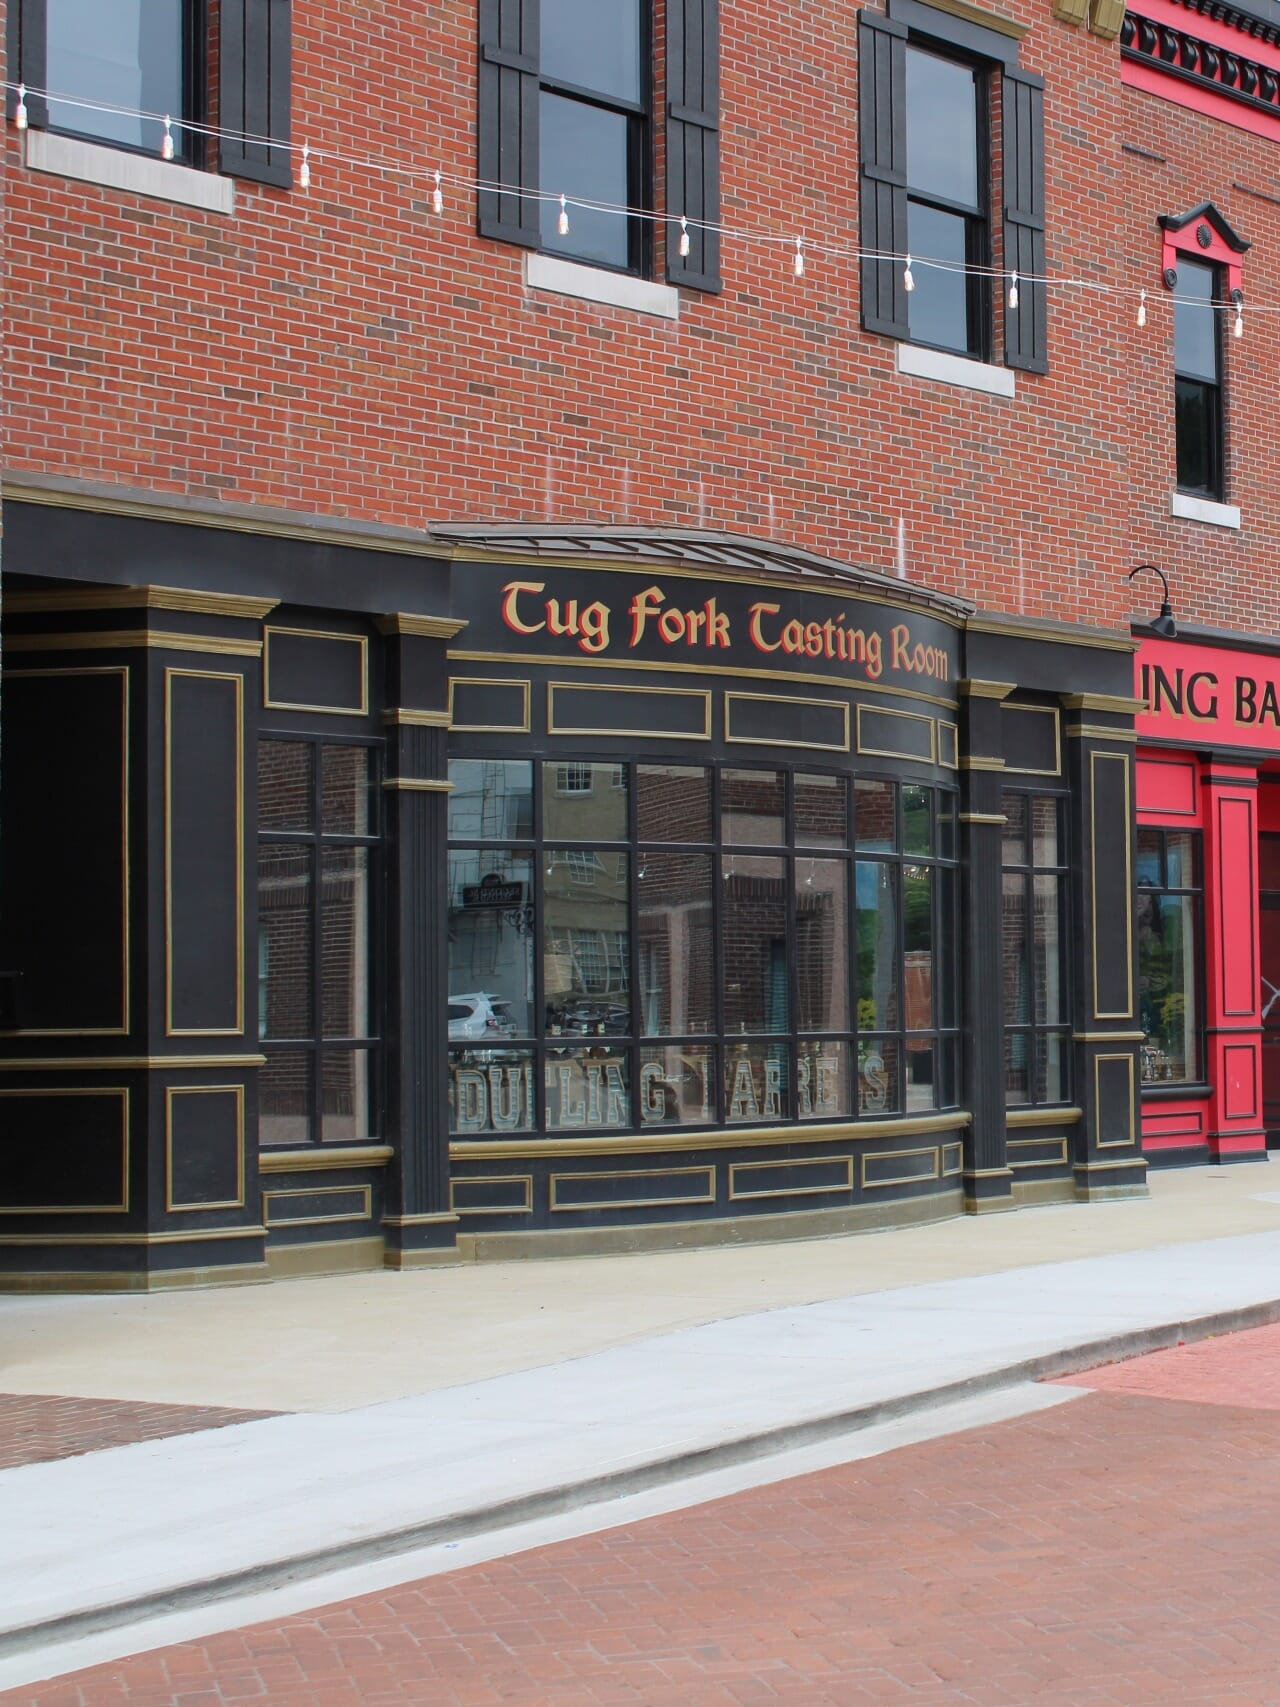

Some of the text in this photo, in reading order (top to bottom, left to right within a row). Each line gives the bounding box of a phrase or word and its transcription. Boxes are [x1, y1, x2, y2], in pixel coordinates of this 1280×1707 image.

[500, 582, 949, 682] Tug Fork Tasting Room
[1138, 664, 1219, 722] ING
